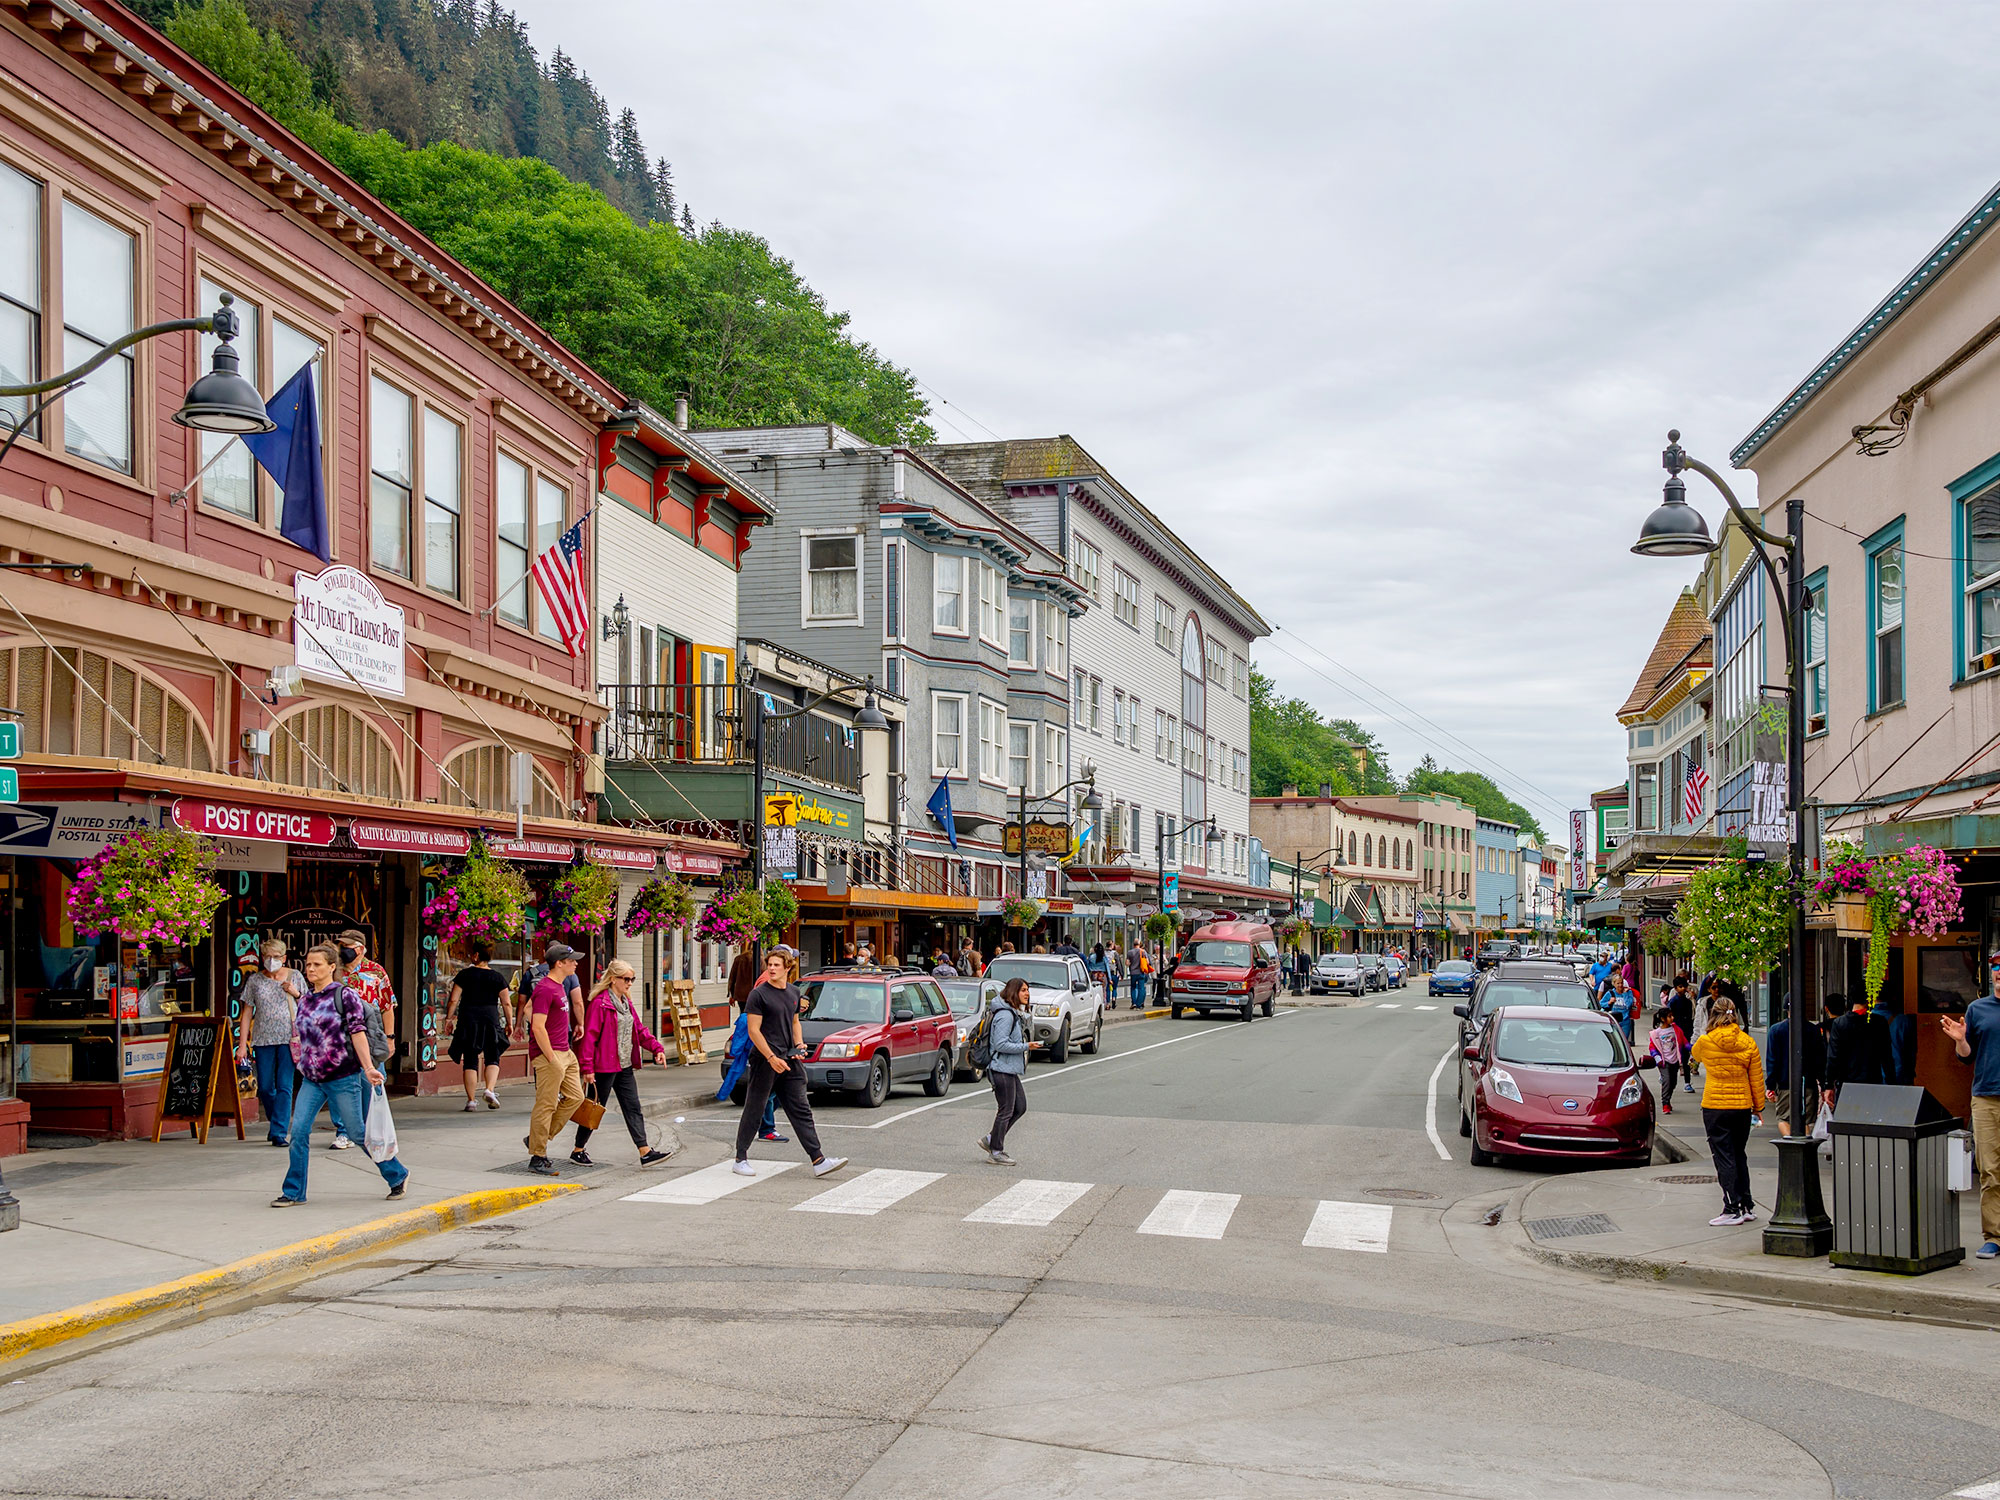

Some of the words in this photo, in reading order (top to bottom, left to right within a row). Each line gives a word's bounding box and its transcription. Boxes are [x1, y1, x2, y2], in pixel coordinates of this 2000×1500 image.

[324, 574, 349, 594] SEWARD
[350, 575, 379, 609] BUILDING
[315, 600, 347, 632] JUNEAU
[348, 611, 381, 642] TRADING
[382, 622, 400, 648] POST
[329, 645, 353, 664] NATIVE
[354, 653, 381, 671] TRADING
[382, 660, 398, 675] POST
[1754, 761, 1770, 784] WE
[1771, 763, 1786, 785] ARE
[2, 780, 11, 795] ST
[1752, 784, 1786, 825] TIDE
[61, 816, 104, 828] UNITED
[205, 805, 251, 832] POST
[256, 811, 311, 838] OFFICE
[57, 830, 101, 843] POSTAL
[360, 826, 383, 840] NATIVE
[385, 828, 410, 843] CARVED
[411, 831, 429, 844] IVORY
[429, 835, 433, 845] &
[434, 833, 465, 847] SOAPSTONE
[766, 829, 779, 840] WE
[781, 828, 797, 840] ARE
[1748, 825, 1787, 842] WATCHERS
[530, 841, 546, 854] INDIAN
[547, 842, 570, 856] MOCCASINS
[766, 840, 797, 849] FORAGERS
[766, 848, 797, 859] HUNTERS
[766, 859, 771, 867] &
[772, 858, 797, 867] FISHERS
[1027, 886, 1046, 898] GRAY
[180, 1028, 213, 1046] KINDRED
[182, 1048, 205, 1066] POST
